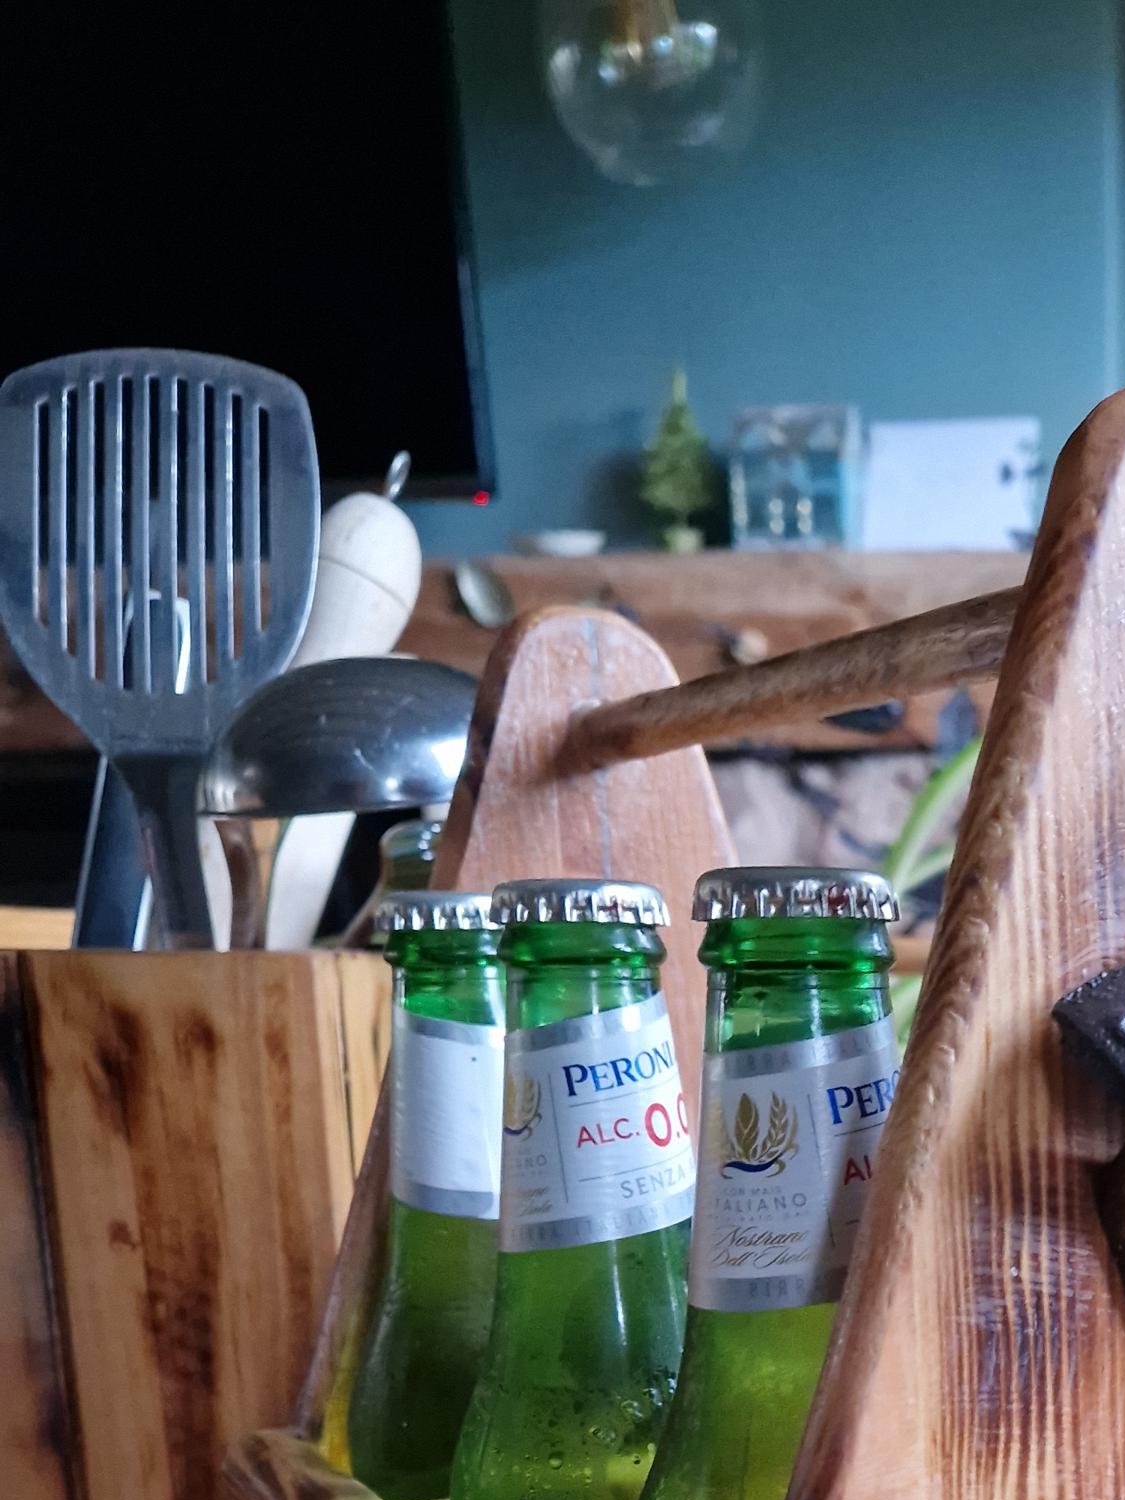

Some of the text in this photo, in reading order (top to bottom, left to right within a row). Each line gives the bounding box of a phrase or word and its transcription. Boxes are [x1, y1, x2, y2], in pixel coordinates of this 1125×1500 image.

[562, 1040, 674, 1097] PERONI
[576, 1118, 640, 1148] ALC.
[620, 1163, 686, 1200] SENZA
